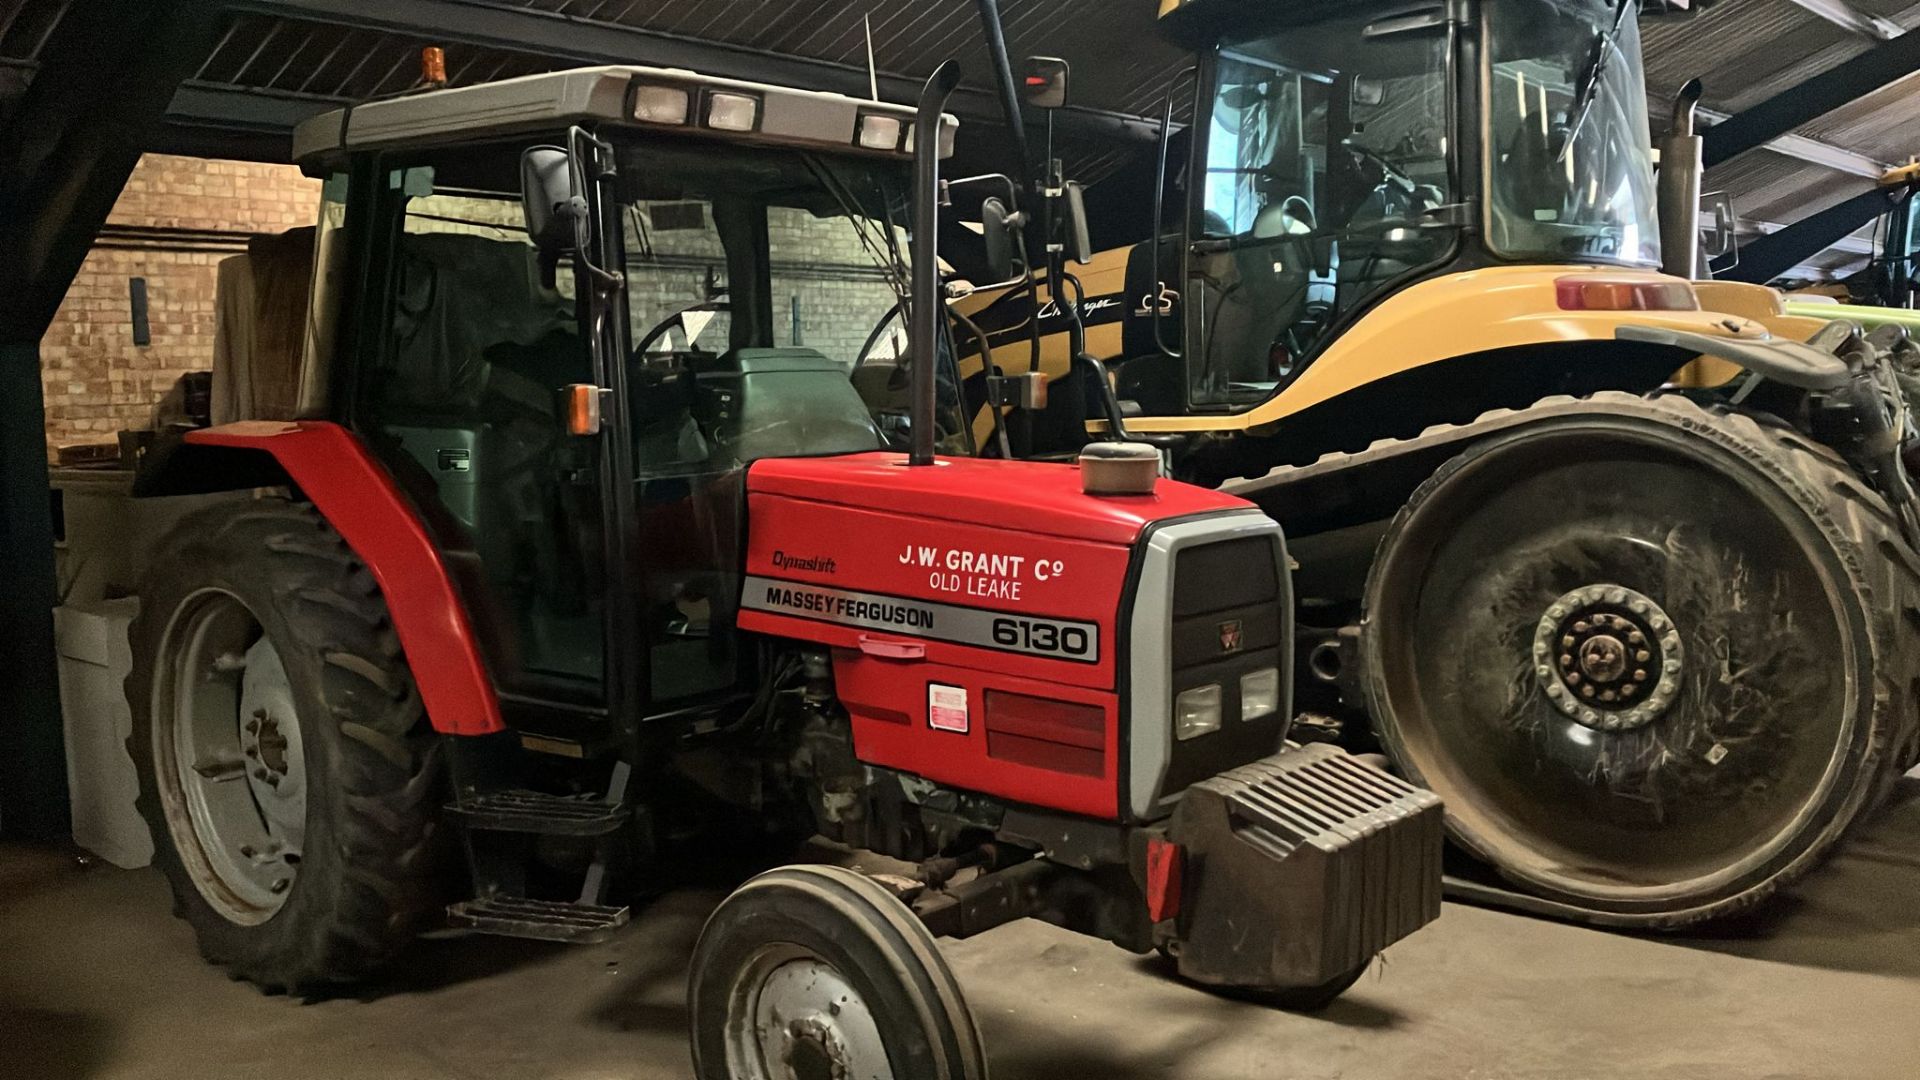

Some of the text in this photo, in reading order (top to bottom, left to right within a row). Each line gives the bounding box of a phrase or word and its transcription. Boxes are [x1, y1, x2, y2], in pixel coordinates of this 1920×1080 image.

[772, 550, 836, 573] Dynashift
[899, 544, 941, 567] J.W.
[946, 550, 1025, 578] GRANT
[929, 572, 1022, 600] OLD LEAKE
[766, 587, 934, 629] MASSEY FERGUSON
[992, 618, 1088, 655] 6130
